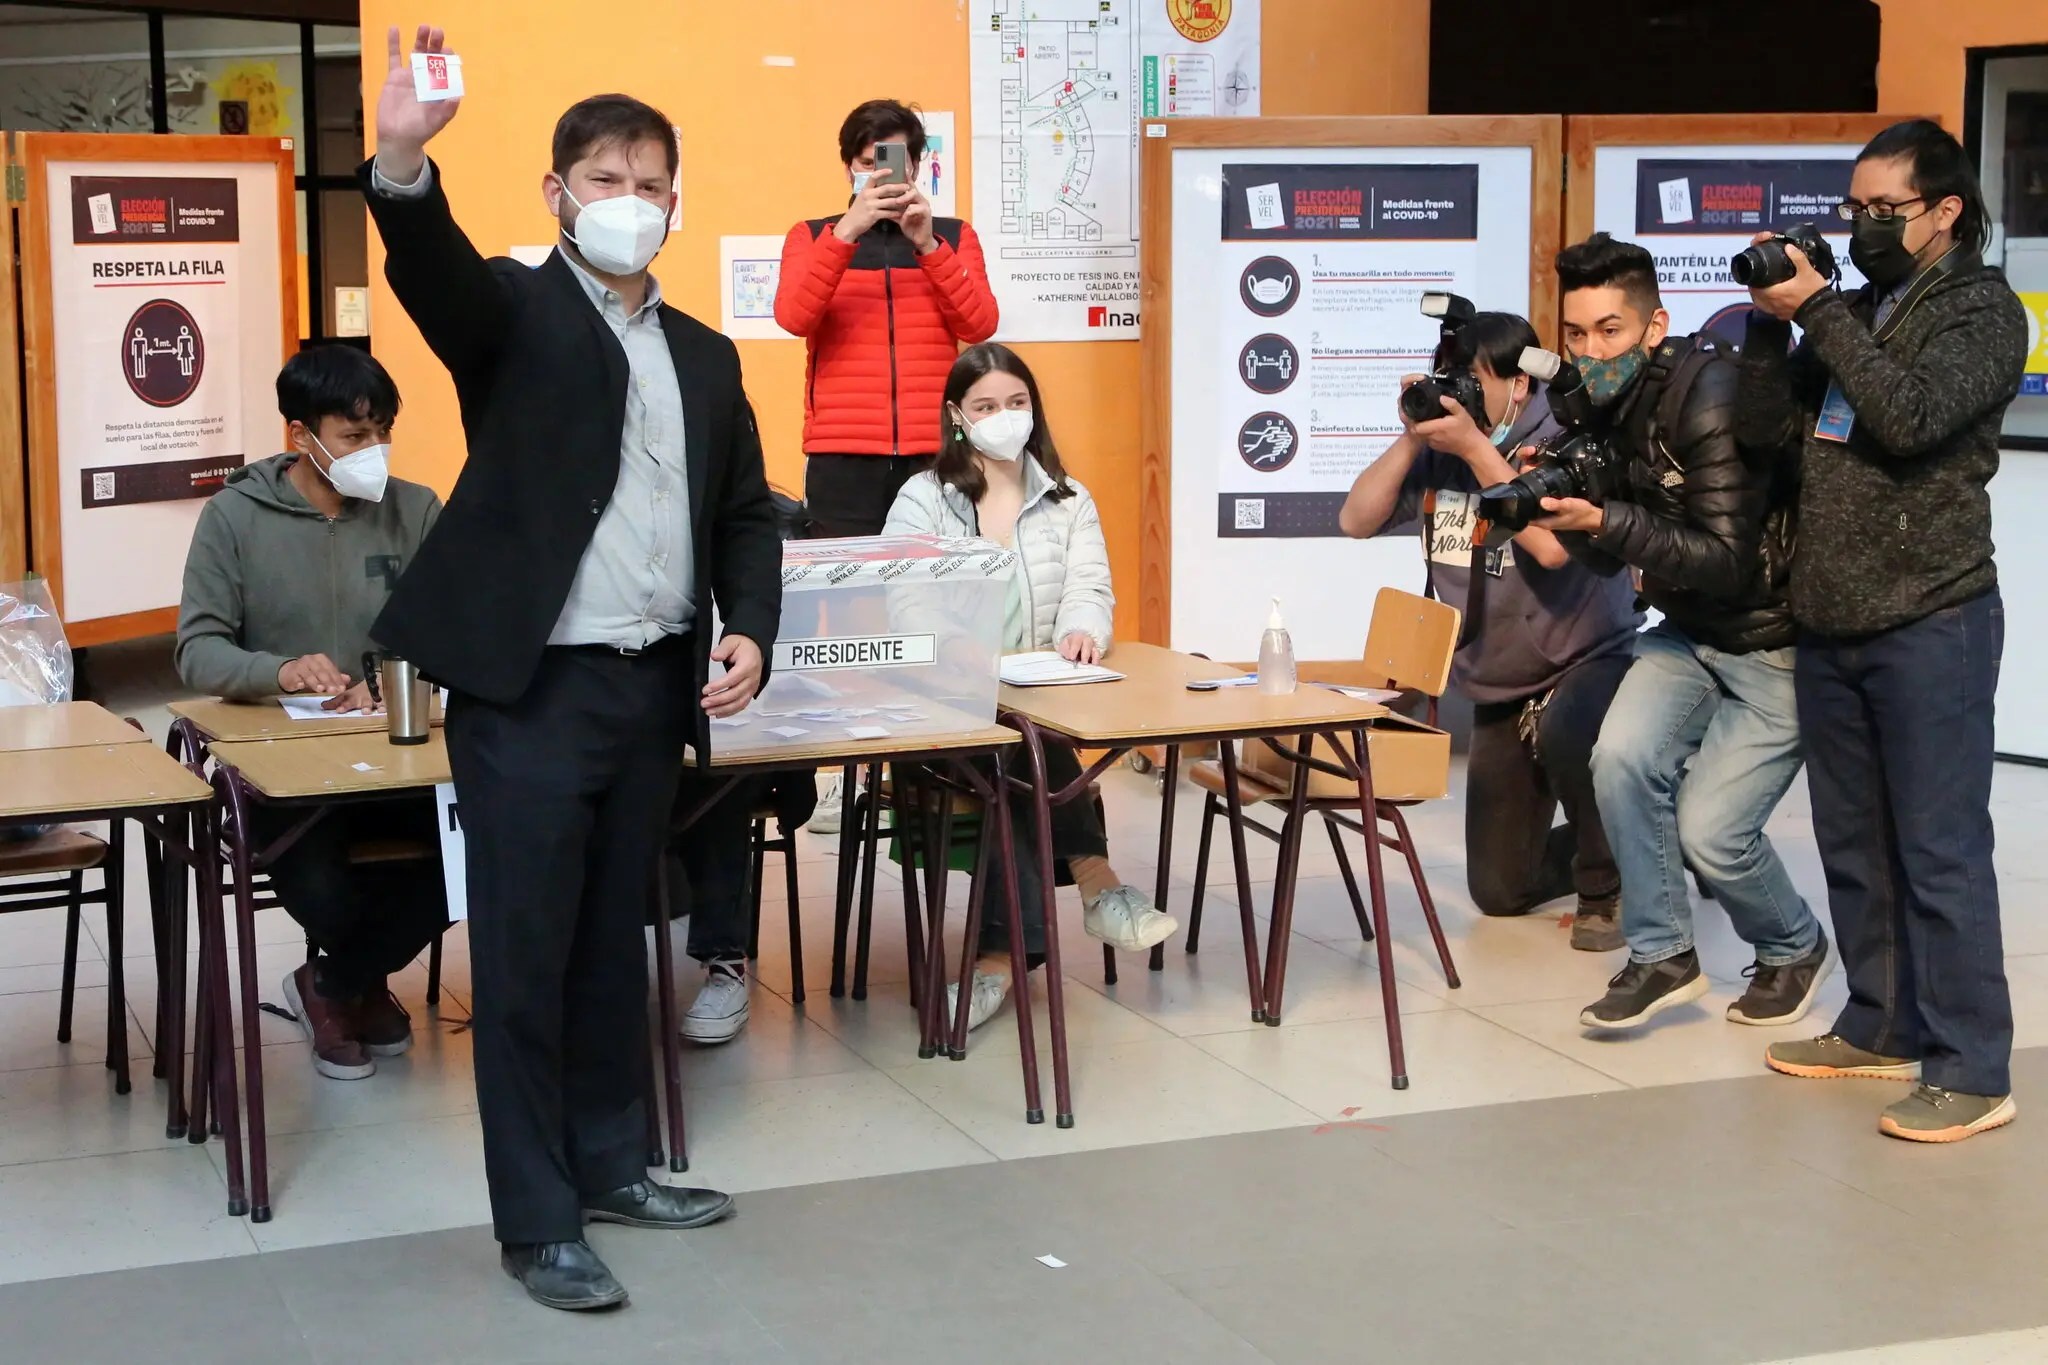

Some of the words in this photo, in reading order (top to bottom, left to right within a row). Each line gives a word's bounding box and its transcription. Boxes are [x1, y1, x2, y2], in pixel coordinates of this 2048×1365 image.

[1174, 17, 1225, 39] PATAGONIA
[1034, 52, 1061, 60] ABIERTO
[429, 59, 446, 70] SER
[1146, 60, 1154, 86] ZONA
[1146, 89, 1154, 101] DE
[1075, 115, 1081, 123] 9
[1081, 135, 1087, 143] 8
[1008, 147, 1014, 156] 3
[1082, 156, 1087, 165] 7
[1008, 168, 1014, 177] 2
[1258, 194, 1274, 206] SER
[1294, 186, 1362, 205] ELECCIÓN
[1780, 194, 1816, 204] Medidas
[1817, 194, 1844, 204] frente
[1383, 199, 1423, 209] Medidas
[1424, 199, 1455, 209] frente
[178, 207, 205, 217] Medidas
[205, 207, 225, 216] frente
[1258, 206, 1273, 218] VEL
[1295, 205, 1362, 216] PRESIDENCIAL
[1382, 210, 1392, 220] al
[1392, 210, 1439, 220] COVID-19
[1780, 205, 1788, 215] al
[1788, 205, 1830, 215] COVID-19
[179, 217, 186, 226] al
[186, 217, 216, 226] COVID-19
[1294, 216, 1334, 230] 2021
[1312, 253, 1322, 267] 1.
[1710, 256, 1727, 267] LA
[93, 261, 166, 278] RESPETA
[169, 260, 190, 276] LA
[192, 260, 225, 275] FILA
[1312, 270, 1328, 278] Usa
[1329, 270, 1338, 278] tu
[1339, 269, 1381, 278] mascarilla
[1394, 270, 1413, 278] todo
[1011, 273, 1061, 282] PROYECTO
[1064, 272, 1075, 281] DE
[1077, 272, 1102, 281] TESIS
[1104, 272, 1121, 281] ING.
[1123, 271, 1136, 280] EN
[1681, 272, 1691, 282] A
[1694, 272, 1712, 282] LO
[1085, 282, 1124, 291] CALIDAD
[1125, 282, 1132, 291] Y
[1037, 293, 1088, 302] KATHERINE
[153, 337, 159, 348] 1
[159, 338, 172, 347] mt.
[1311, 331, 1322, 344] 2.
[1311, 347, 1323, 355] No
[1324, 347, 1354, 356] llegues
[1354, 346, 1406, 356] acompañado
[1310, 408, 1322, 423] 3.
[105, 423, 134, 433] Respeta
[134, 421, 142, 430] la
[143, 420, 175, 429] distancia
[1310, 425, 1354, 433] Desinfecta
[1361, 425, 1379, 433] lava
[1380, 425, 1394, 433] tus
[105, 435, 125, 443] suelo
[126, 434, 143, 443] para
[143, 432, 154, 440] las
[172, 429, 195, 439] dentro
[140, 443, 158, 452] local
[158, 442, 168, 450] de
[168, 440, 200, 450] votación.
[1433, 508, 1467, 531] The
[792, 640, 904, 666] PRESIDENTE
